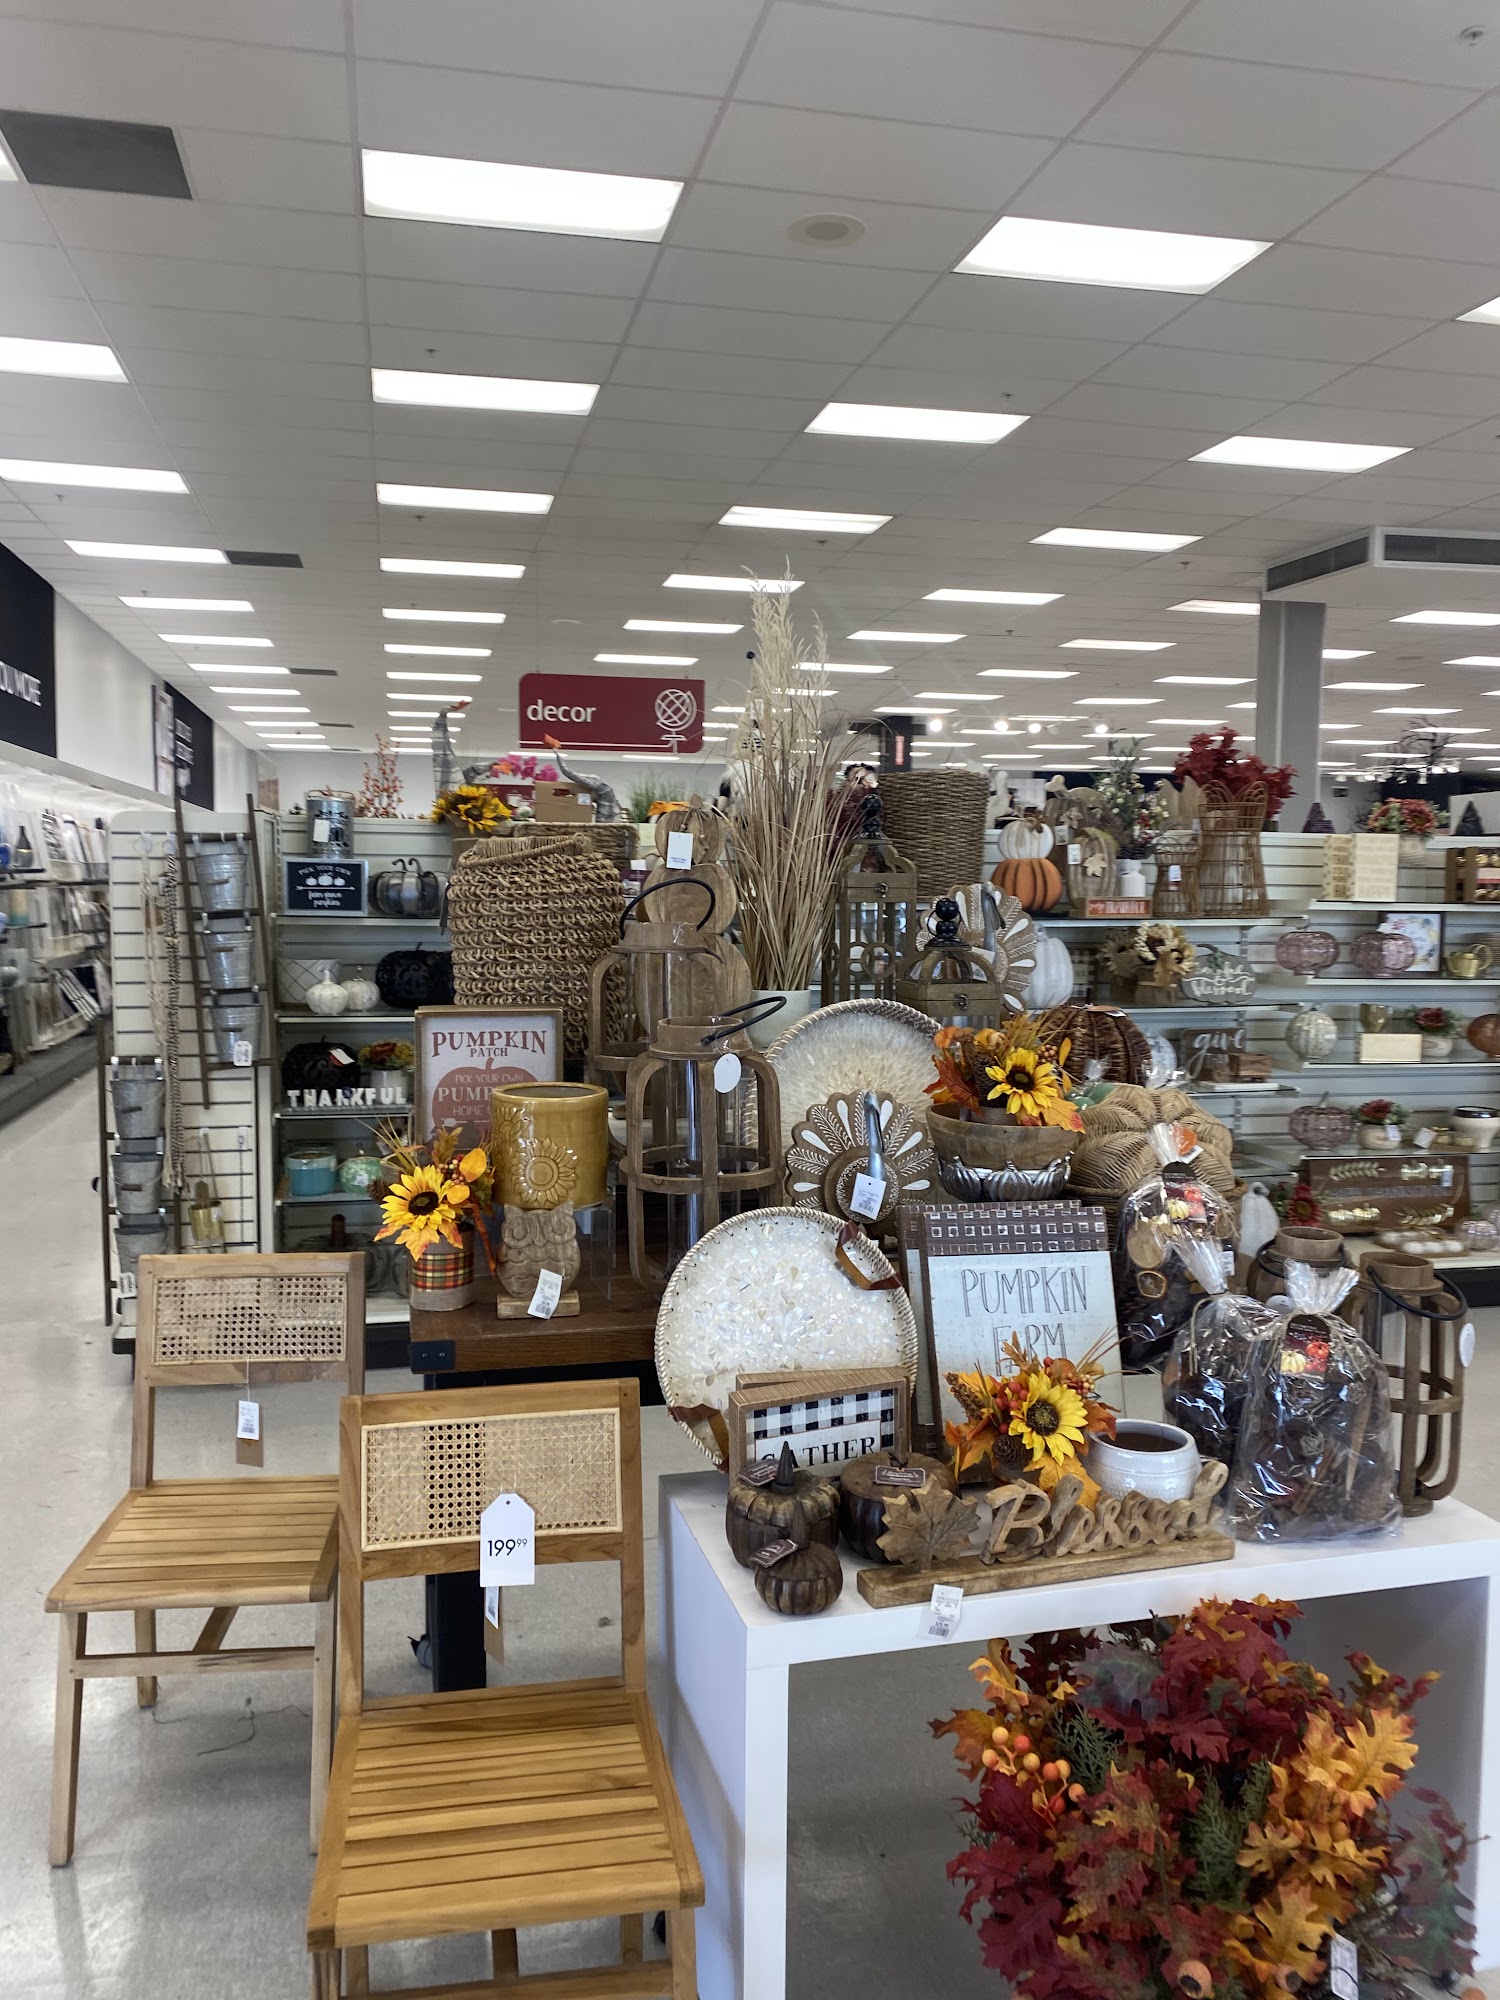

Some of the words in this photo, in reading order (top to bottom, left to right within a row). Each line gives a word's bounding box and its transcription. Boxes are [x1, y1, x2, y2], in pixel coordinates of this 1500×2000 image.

[526, 698, 597, 723] decor
[431, 1030, 547, 1057] PUMPKIN
[470, 1048, 508, 1058] PATCH
[455, 1074, 473, 1084] PICK
[476, 1074, 500, 1083] YOUR
[502, 1073, 524, 1083] OWN
[287, 1087, 407, 1107] THANKFUL
[437, 1086, 494, 1102] PUMP
[453, 1105, 484, 1116] HOME
[961, 1265, 1088, 1317] PUMPKIN
[992, 1323, 1068, 1376] FRM
[979, 1459, 1224, 1565] Blessed
